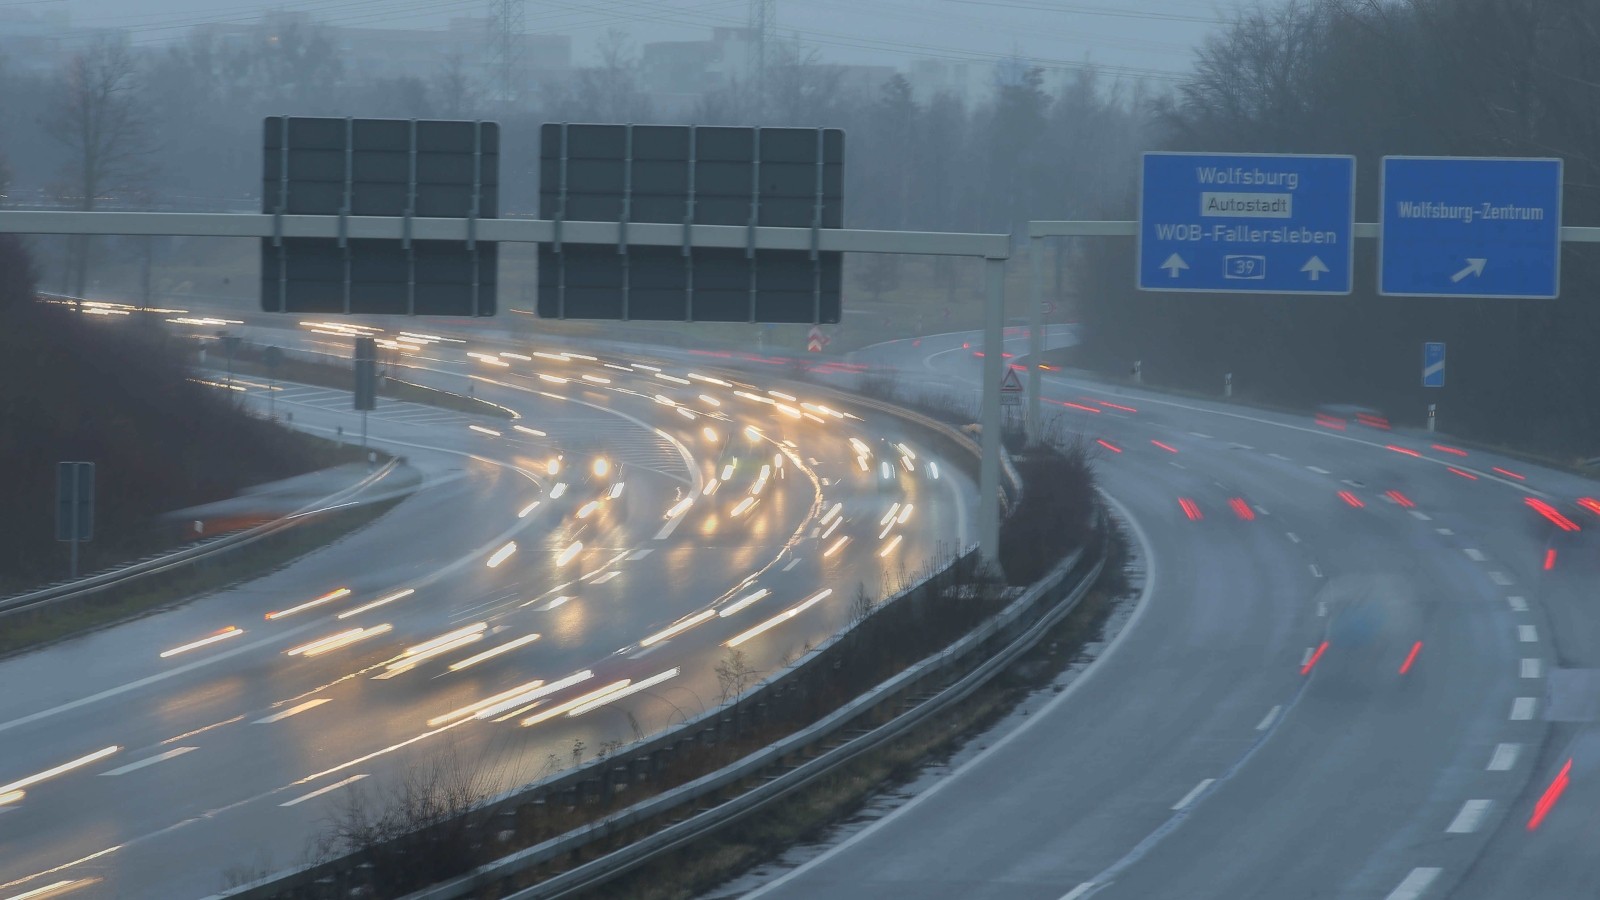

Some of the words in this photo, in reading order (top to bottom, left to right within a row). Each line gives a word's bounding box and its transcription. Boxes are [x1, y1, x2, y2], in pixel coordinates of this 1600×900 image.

[1197, 167, 1298, 189] Wolfsburg
[1207, 198, 1288, 212] Autostadt
[1398, 201, 1544, 223] Wolfsburg-Zentrum
[1156, 223, 1337, 244] WOB-Fallersleben
[1234, 260, 1256, 275] 39
